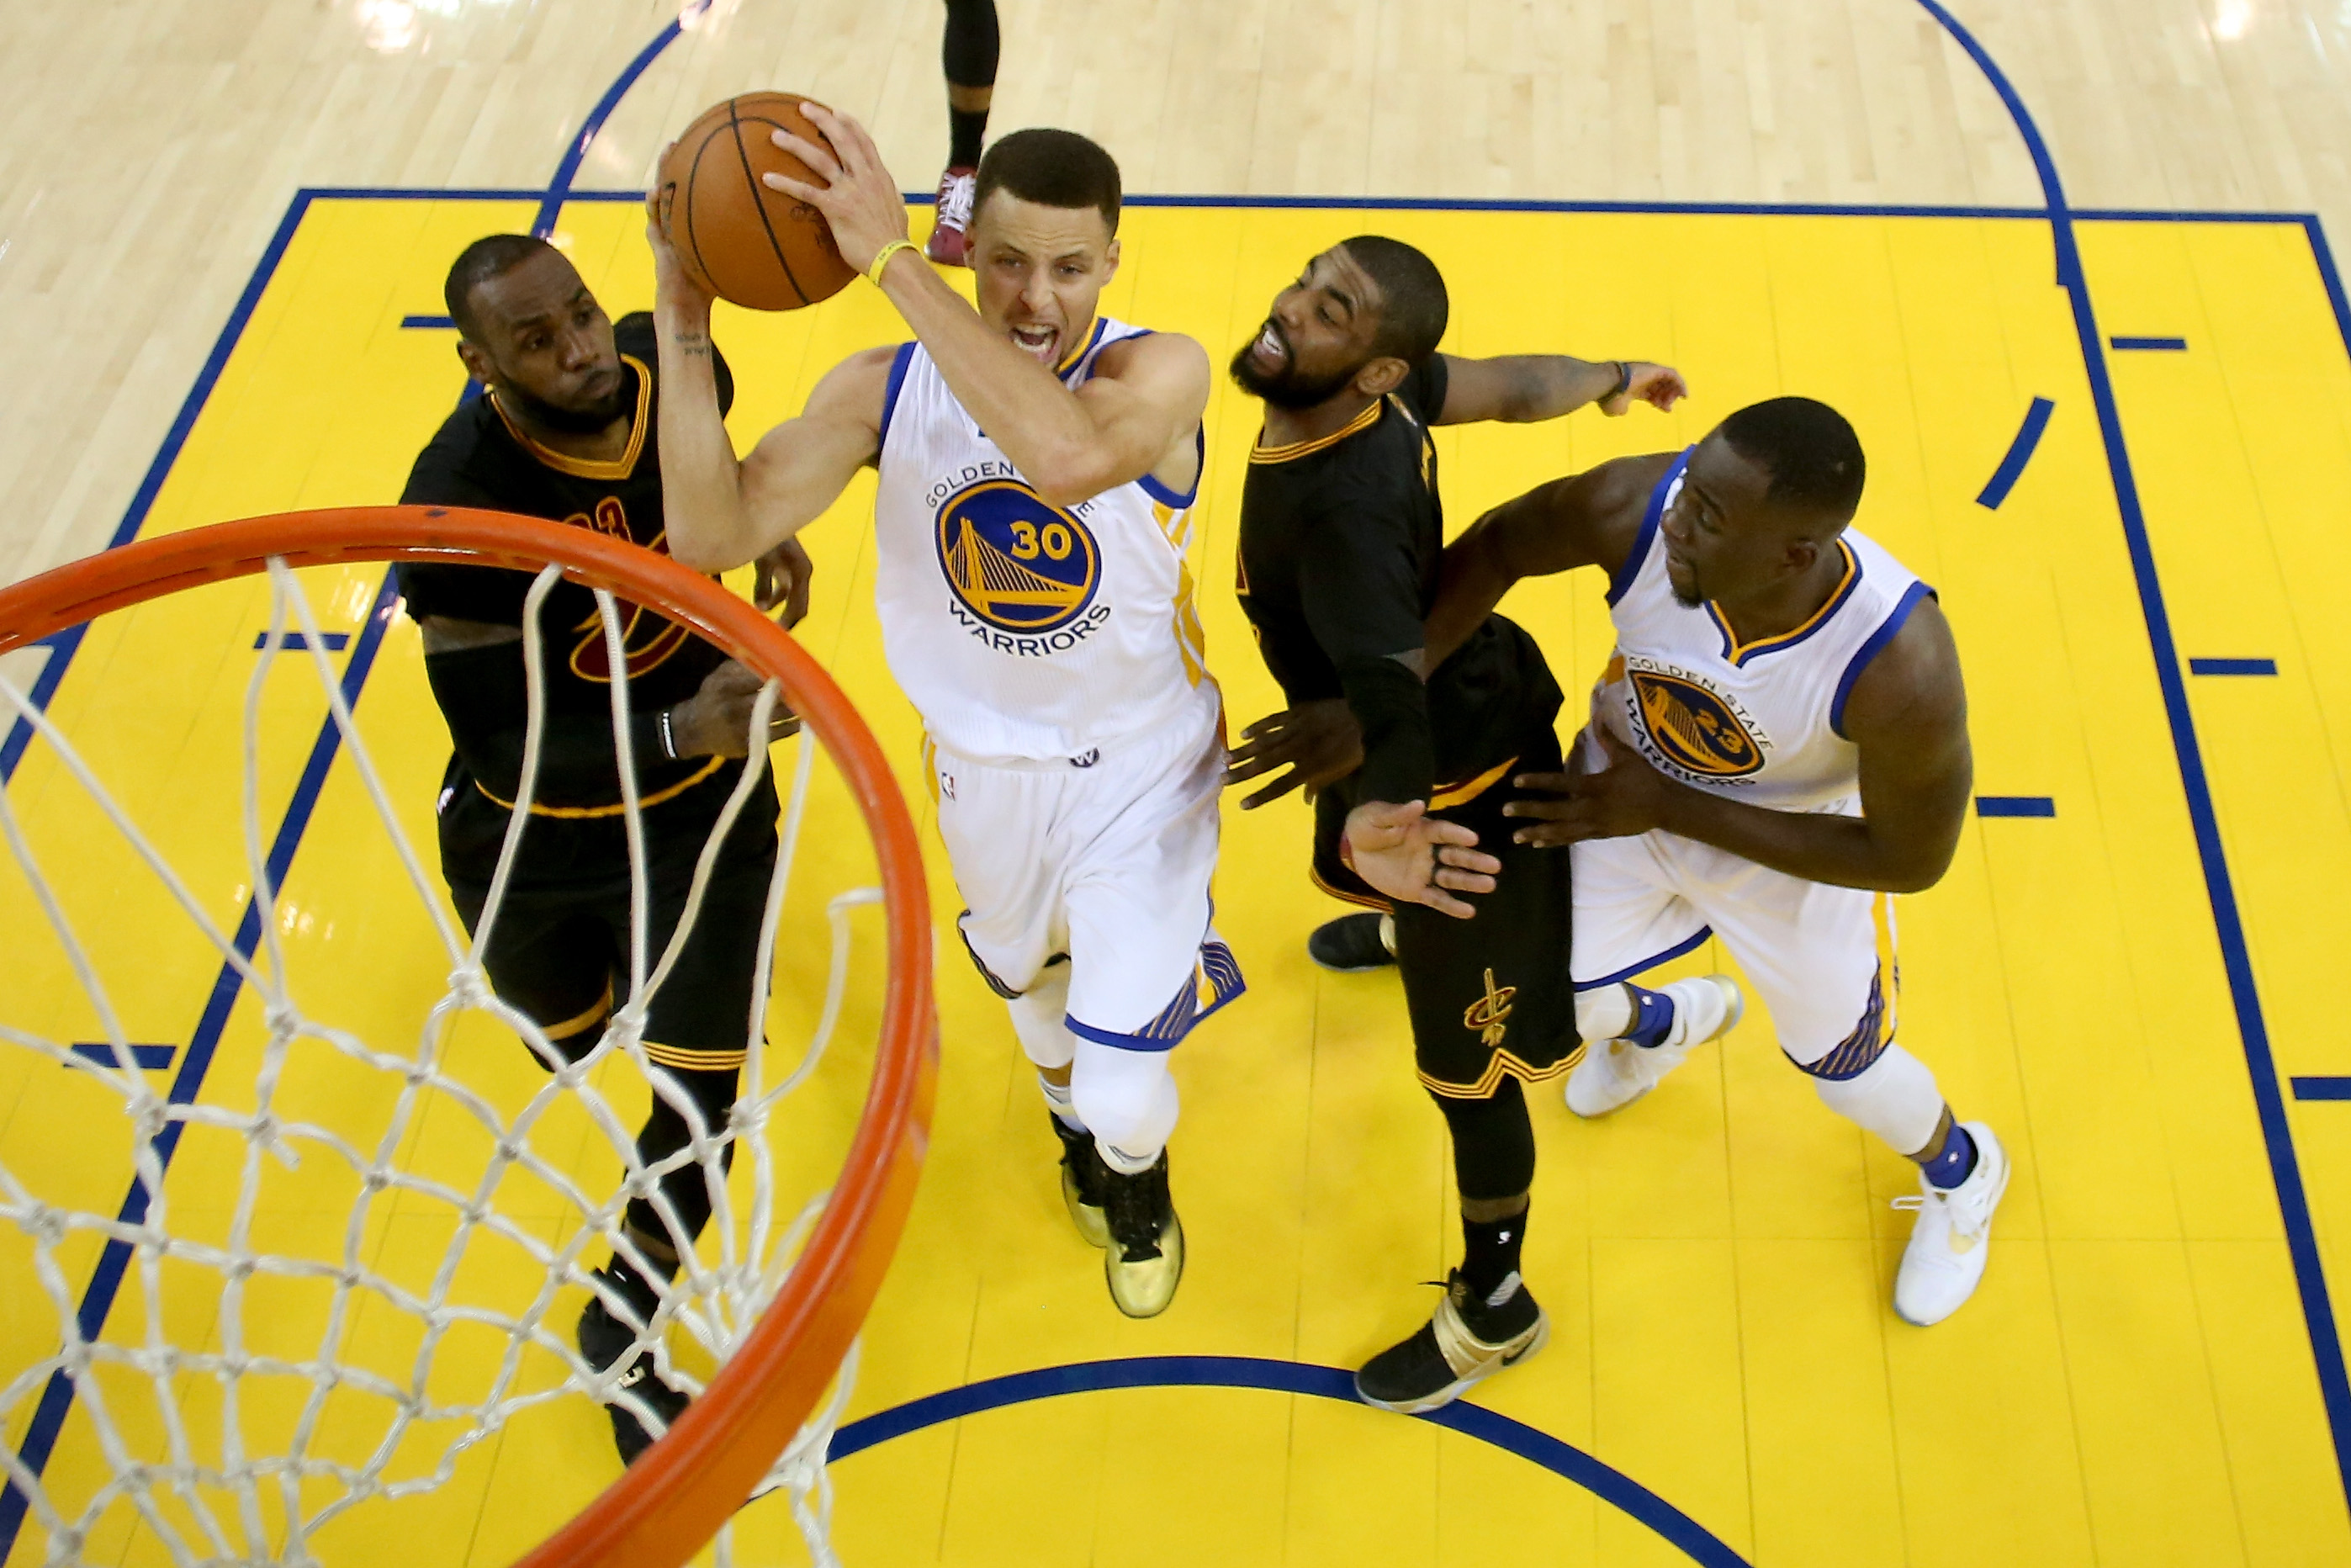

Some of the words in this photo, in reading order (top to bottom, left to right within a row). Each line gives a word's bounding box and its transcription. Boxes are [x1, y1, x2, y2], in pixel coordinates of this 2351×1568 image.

[926, 462, 1015, 508] GOLDEN
[1009, 520, 1073, 561] 30
[949, 598, 1112, 657] WARRIORS
[1629, 657, 1716, 691] GOLDEN
[1724, 693, 1774, 750] STATE
[1626, 698, 1757, 787] WARRIORS
[1695, 708, 1745, 755] 23
